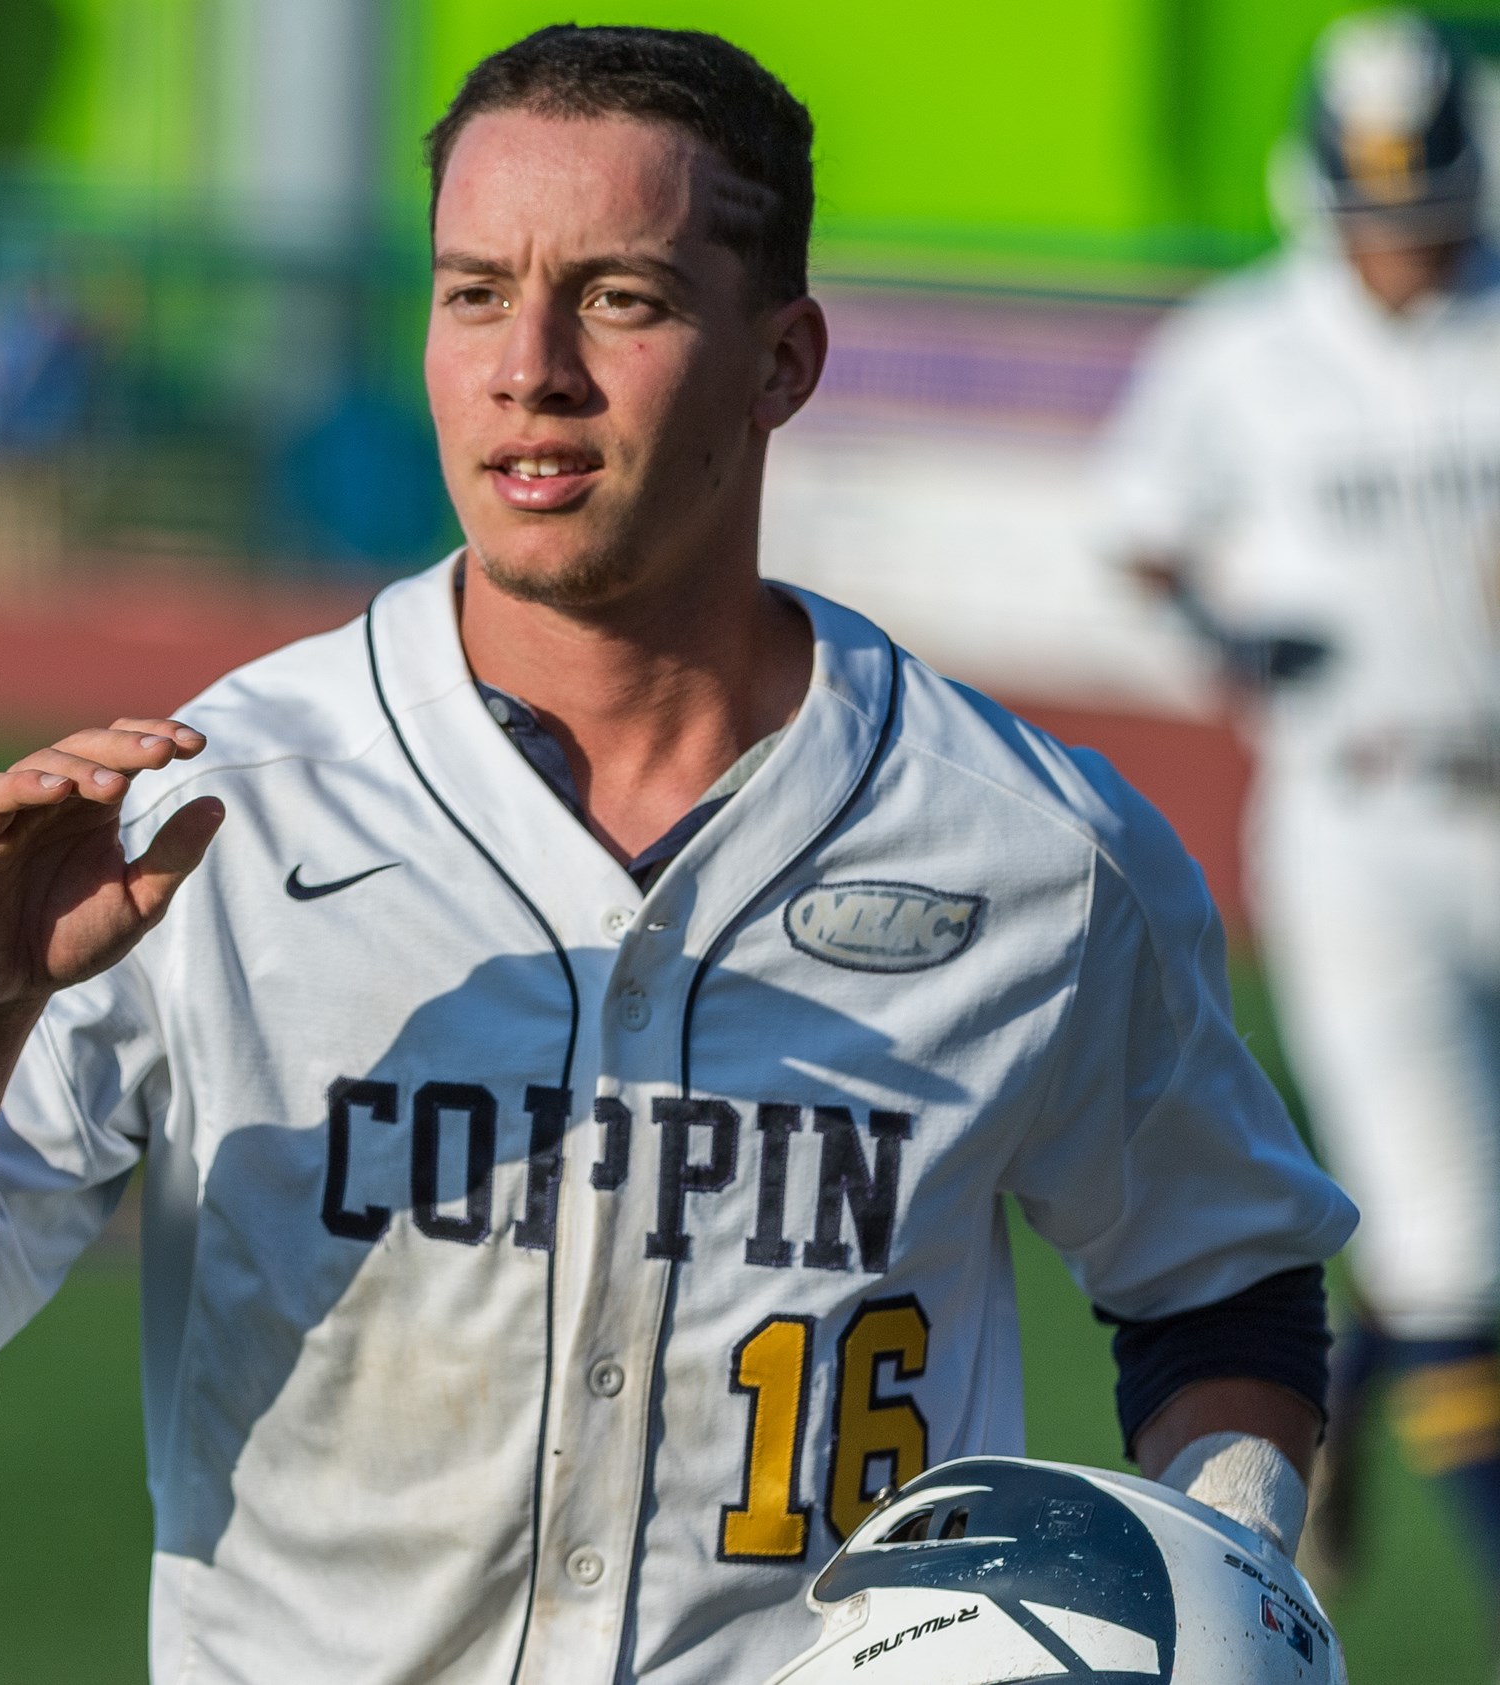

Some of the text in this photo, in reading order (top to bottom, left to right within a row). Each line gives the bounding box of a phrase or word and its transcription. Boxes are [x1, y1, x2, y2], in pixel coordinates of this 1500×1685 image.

[320, 1075, 912, 1274] COPPIN
[716, 1293, 932, 1563] 16
[852, 1604, 981, 1671] RAWLINGS
[1222, 1553, 1330, 1649] RAWLINGS
